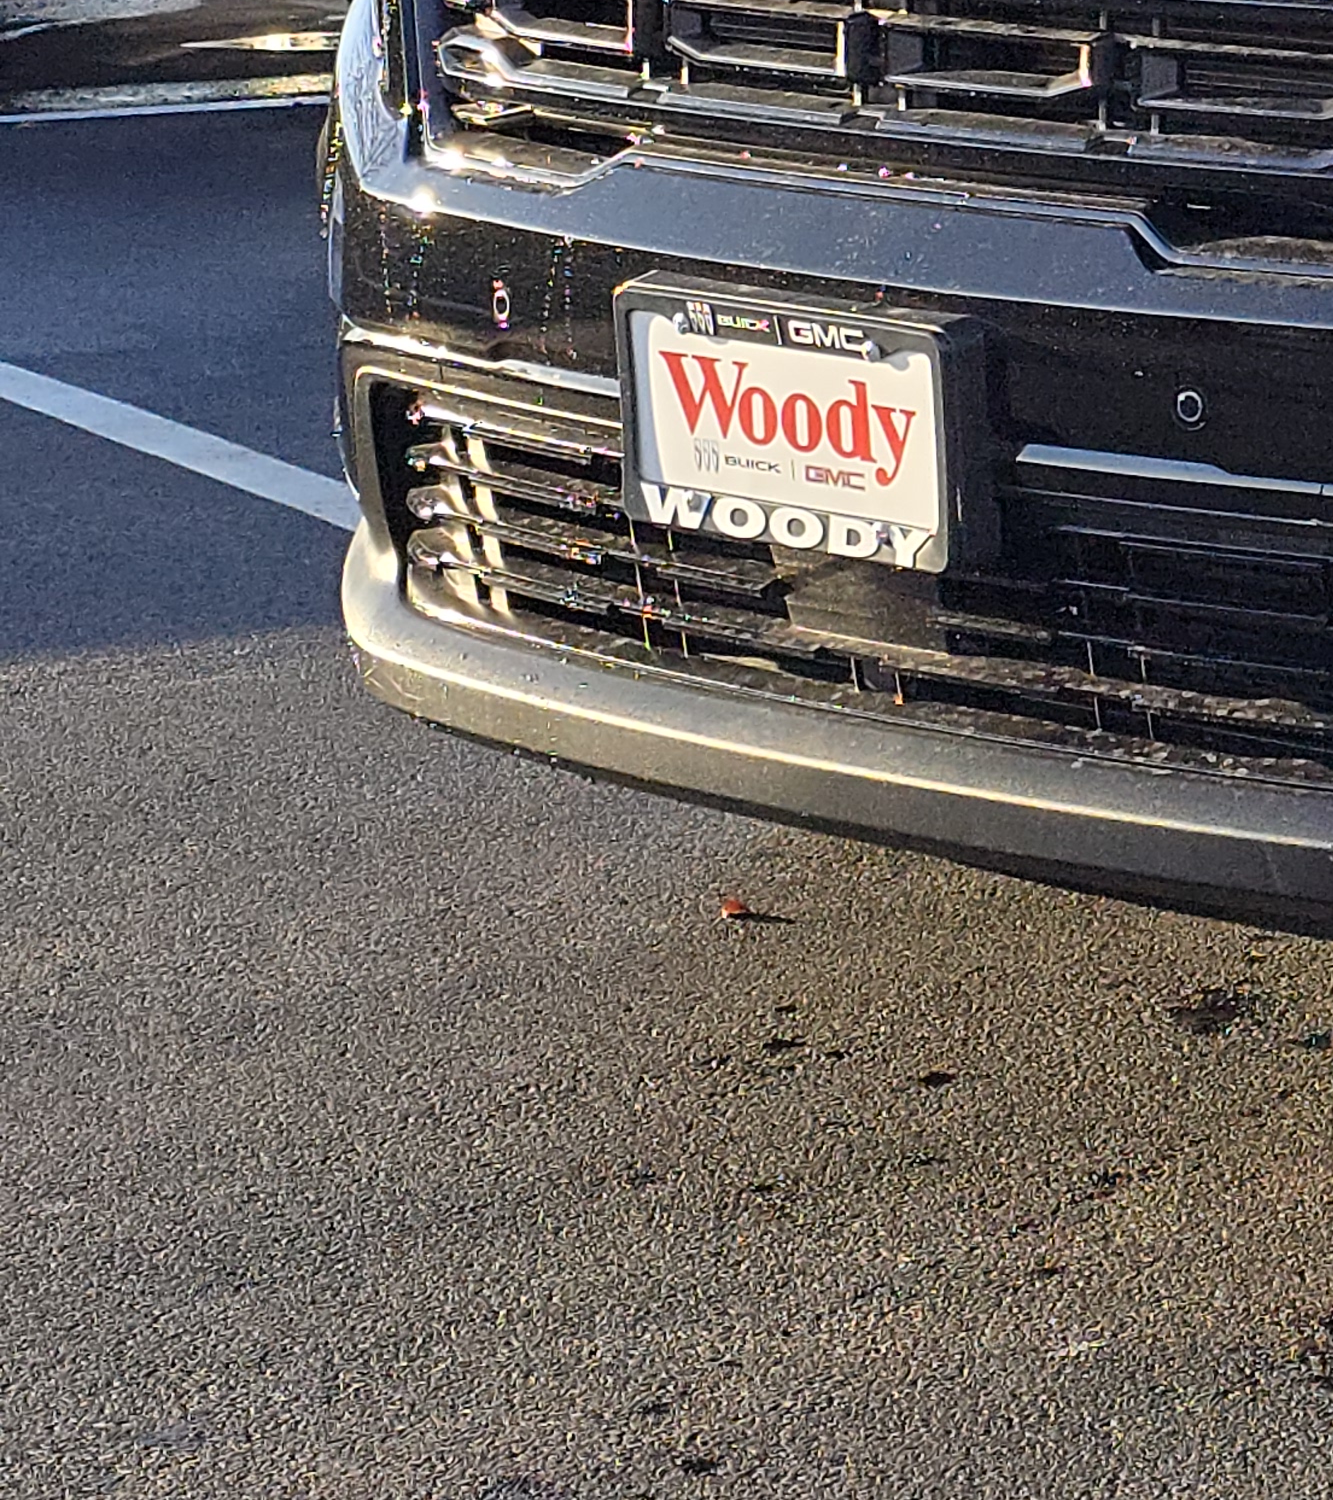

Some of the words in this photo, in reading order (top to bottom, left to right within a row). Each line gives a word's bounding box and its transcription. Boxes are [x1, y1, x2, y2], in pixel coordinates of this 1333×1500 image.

[717, 314, 771, 333] BUICK
[787, 320, 866, 353] GMC
[659, 350, 917, 487] Woody
[724, 454, 782, 475] BUICK
[805, 464, 866, 491] GMC
[641, 482, 935, 569] WOODY
